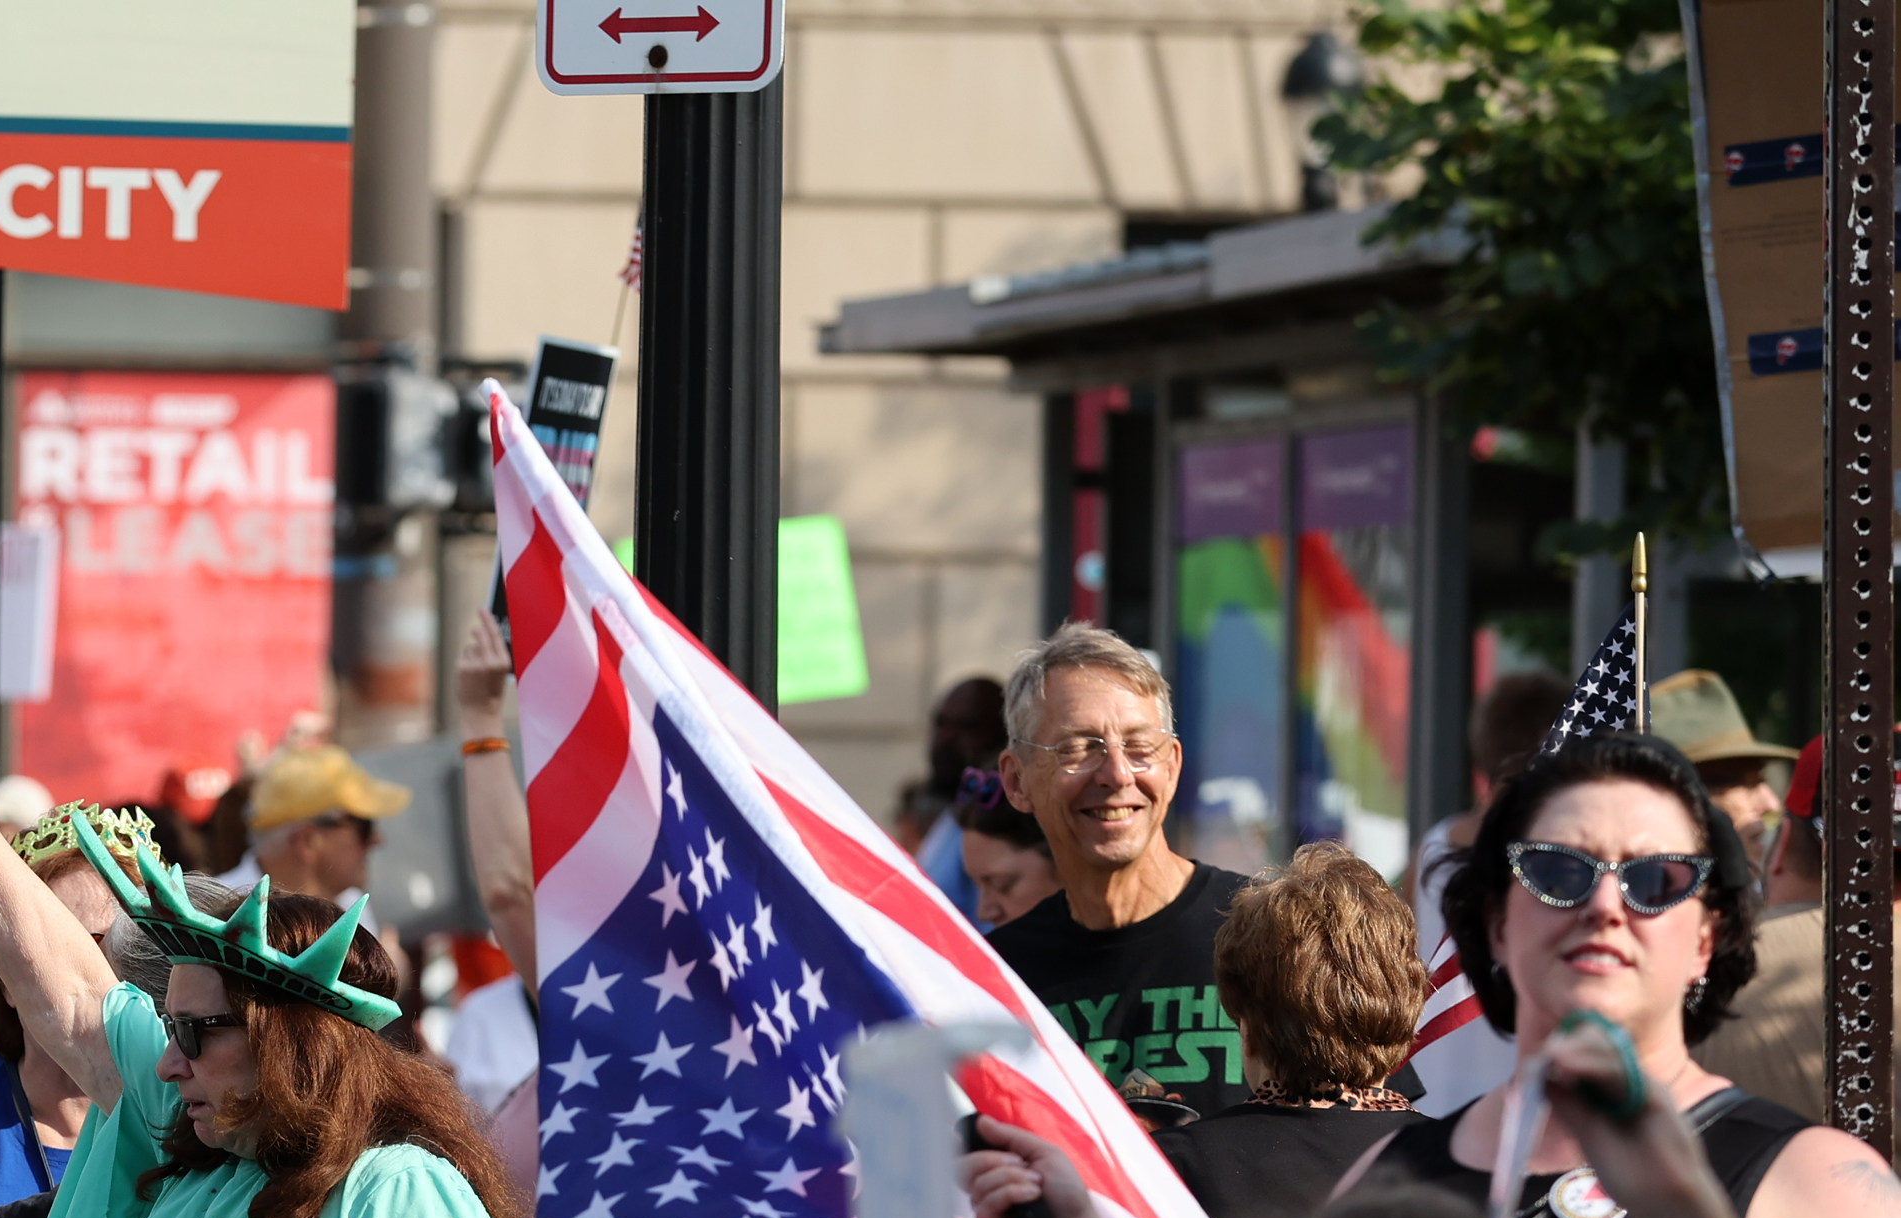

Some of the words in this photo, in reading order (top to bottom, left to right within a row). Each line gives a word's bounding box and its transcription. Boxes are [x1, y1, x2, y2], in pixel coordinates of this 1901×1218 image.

[20, 427, 336, 504] RETAIL
[66, 505, 334, 577] LEASE
[1049, 993, 1120, 1041] AY
[1084, 1030, 1243, 1086] REST
